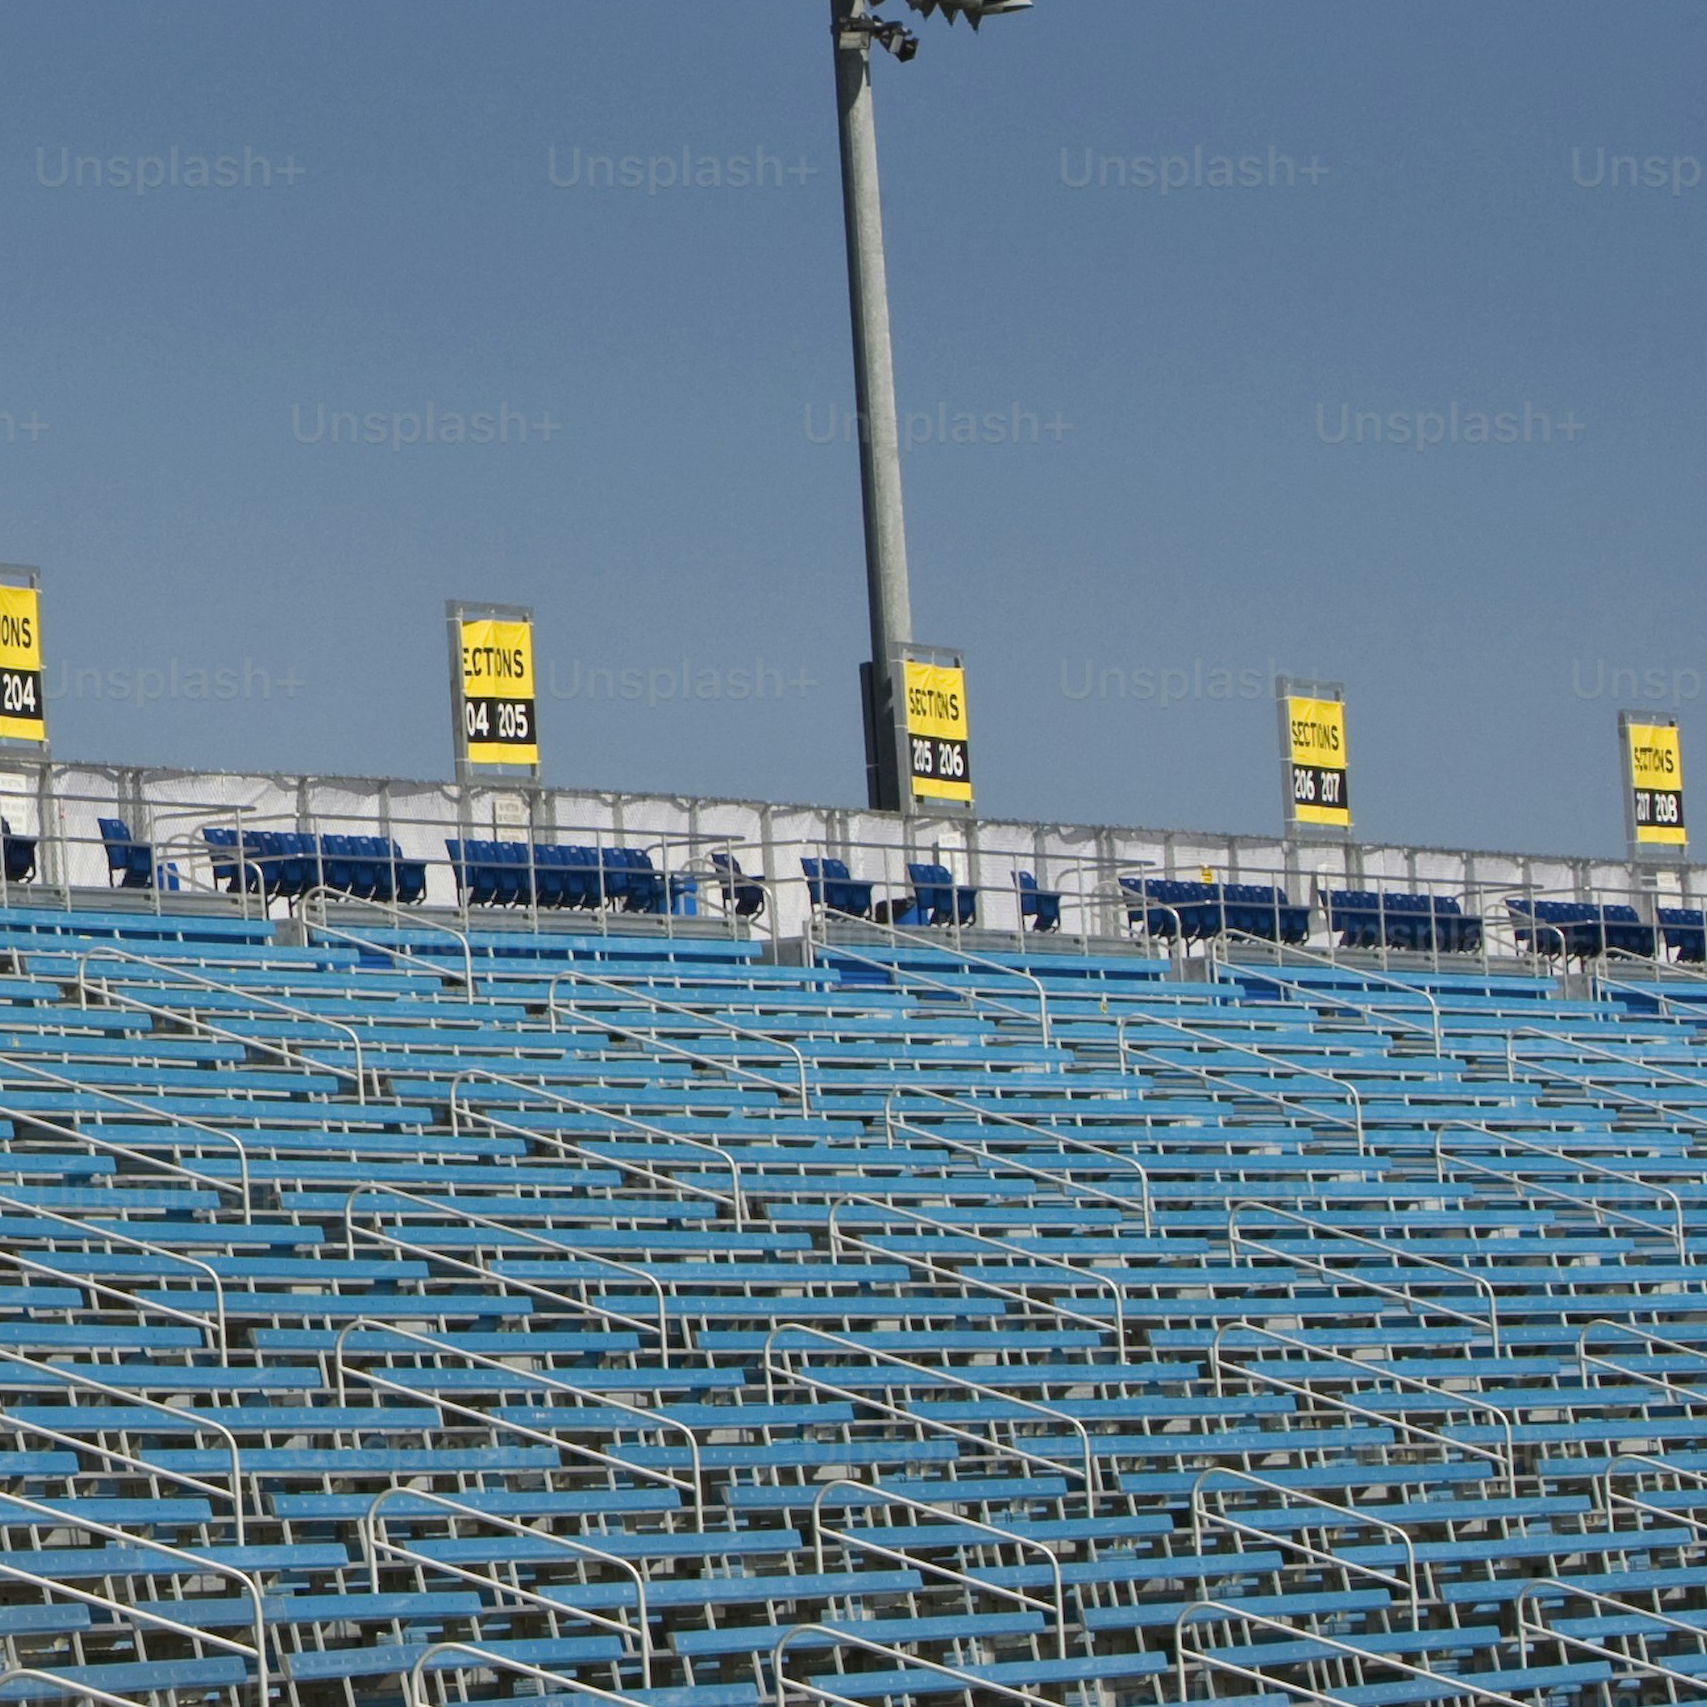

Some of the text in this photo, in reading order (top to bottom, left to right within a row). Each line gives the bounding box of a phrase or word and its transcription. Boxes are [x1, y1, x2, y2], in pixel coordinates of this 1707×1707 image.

[463, 647, 524, 678] ECTIONS
[2, 673, 36, 712] 204
[465, 701, 528, 738] 04 205
[912, 738, 964, 777] 205 206
[1294, 768, 1340, 803] 206 207
[1655, 793, 1678, 823] 208
